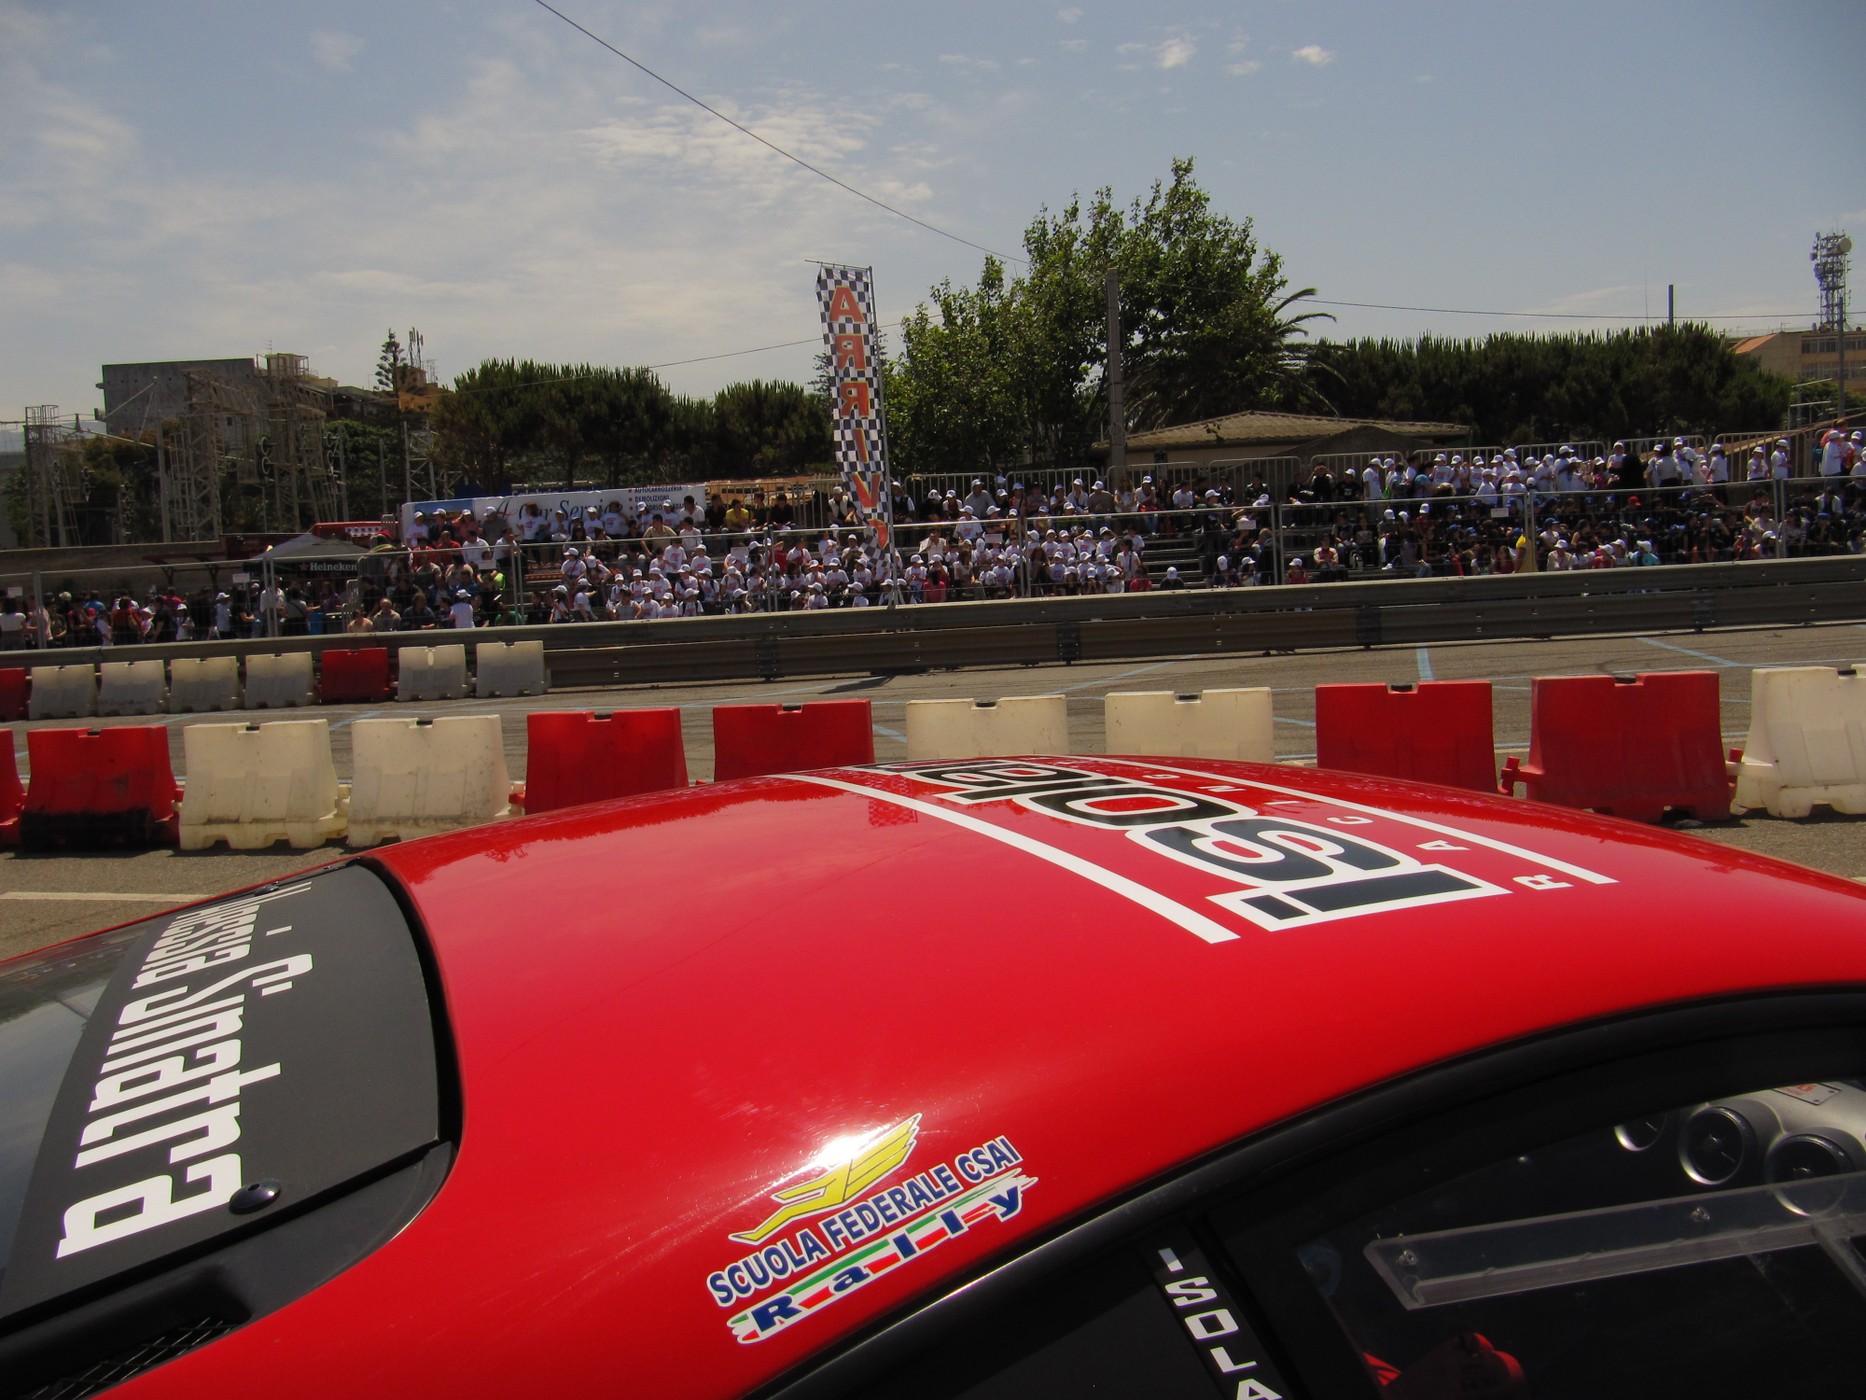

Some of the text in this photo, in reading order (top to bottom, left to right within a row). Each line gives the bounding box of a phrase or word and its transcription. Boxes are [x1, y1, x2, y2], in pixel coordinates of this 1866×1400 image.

[310, 562, 358, 572] Heineken
[560, 499, 624, 521] Seric
[1142, 773, 1574, 891] RACING
[56, 881, 313, 1259] Alessia Sinatra
[707, 1135, 1024, 1306] SCUOLA FEDERALE CSAI
[750, 1184, 1023, 1333] Rally
